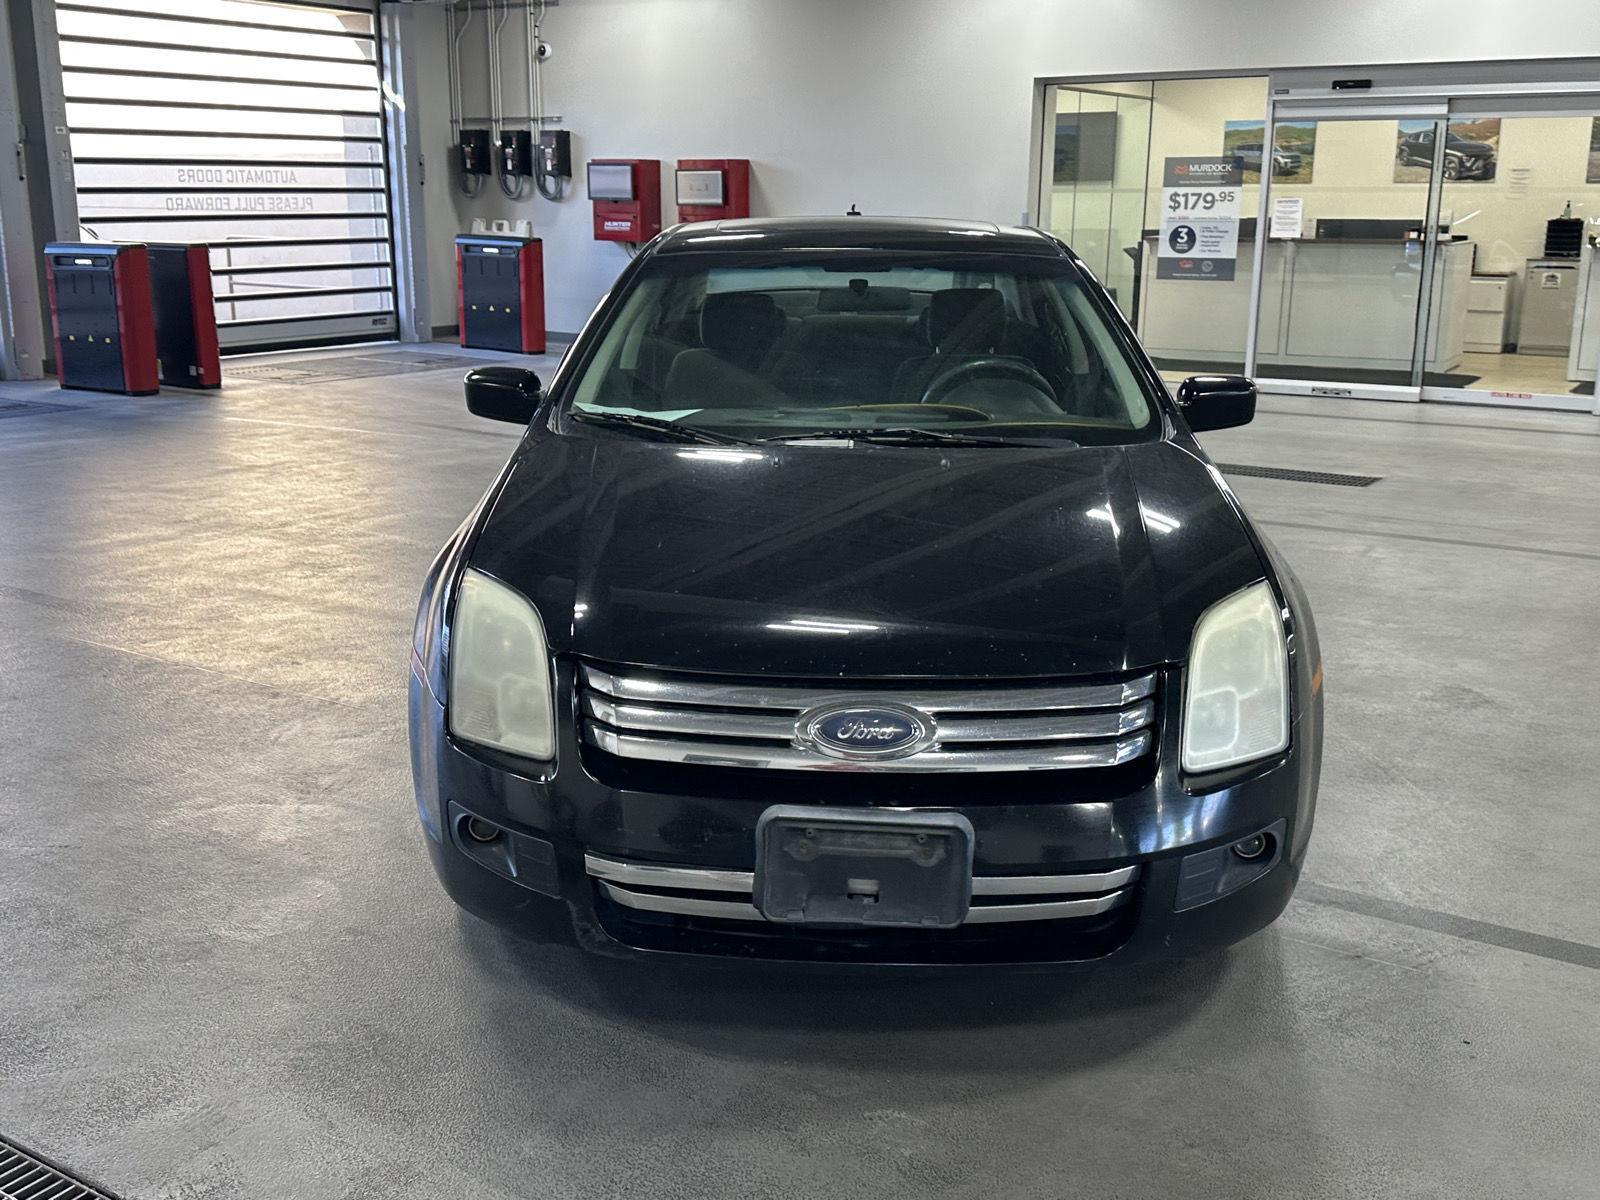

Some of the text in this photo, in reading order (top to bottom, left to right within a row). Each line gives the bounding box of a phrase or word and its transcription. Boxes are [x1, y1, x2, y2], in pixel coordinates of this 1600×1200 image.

[1189, 163, 1232, 172] MURDOCK
[1168, 191, 1235, 212] $179.95
[1177, 227, 1188, 243] 3
[838, 718, 899, 739] Ford
